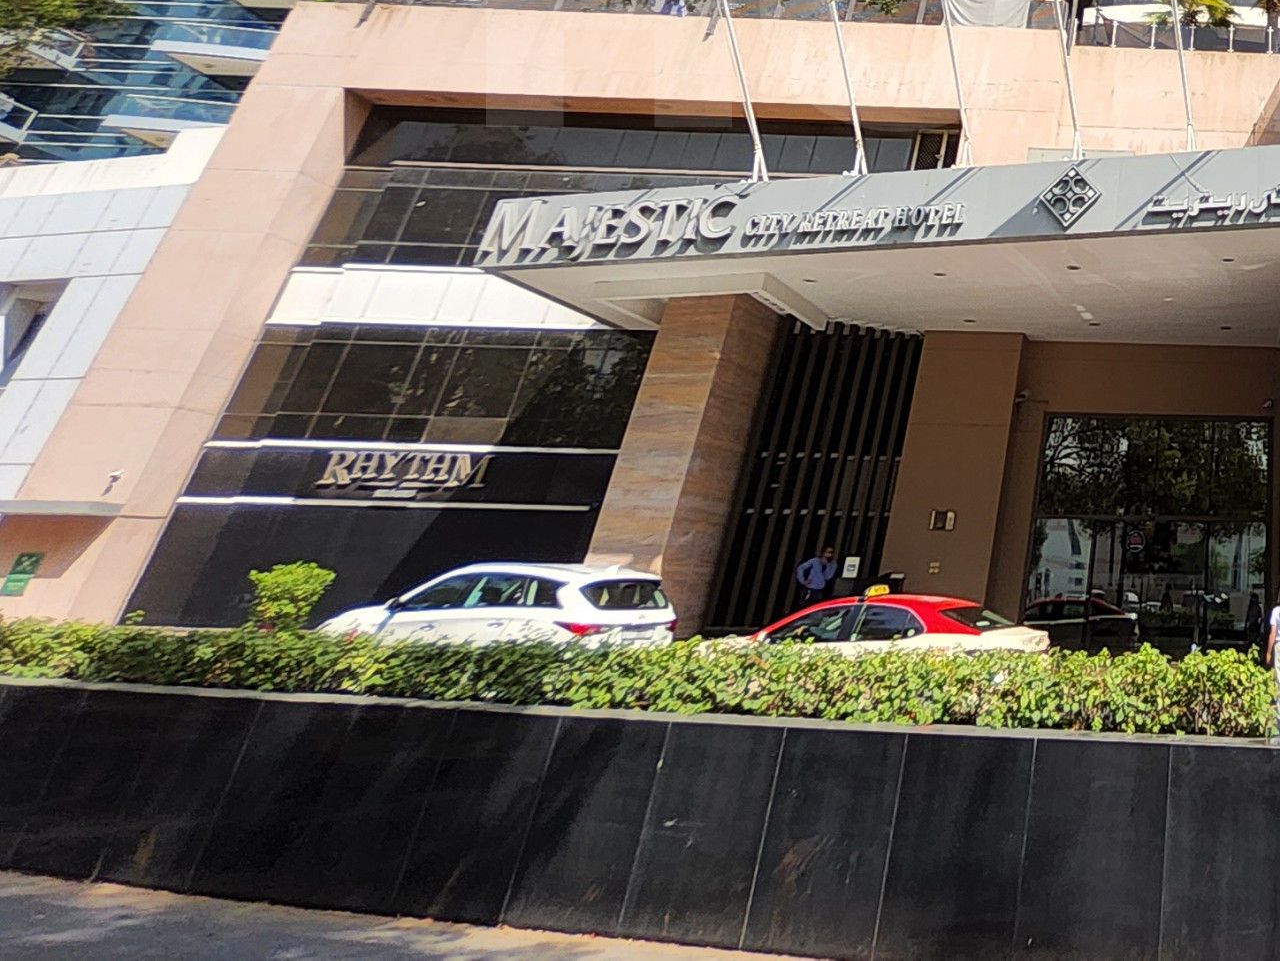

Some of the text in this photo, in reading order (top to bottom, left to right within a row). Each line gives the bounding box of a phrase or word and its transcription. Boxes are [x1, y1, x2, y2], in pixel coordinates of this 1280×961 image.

[1147, 191, 1248, 218] ريتريت
[479, 194, 966, 260] MAJESTIC CITY RETREAT HOTEL
[315, 450, 495, 487] RHYTHM
